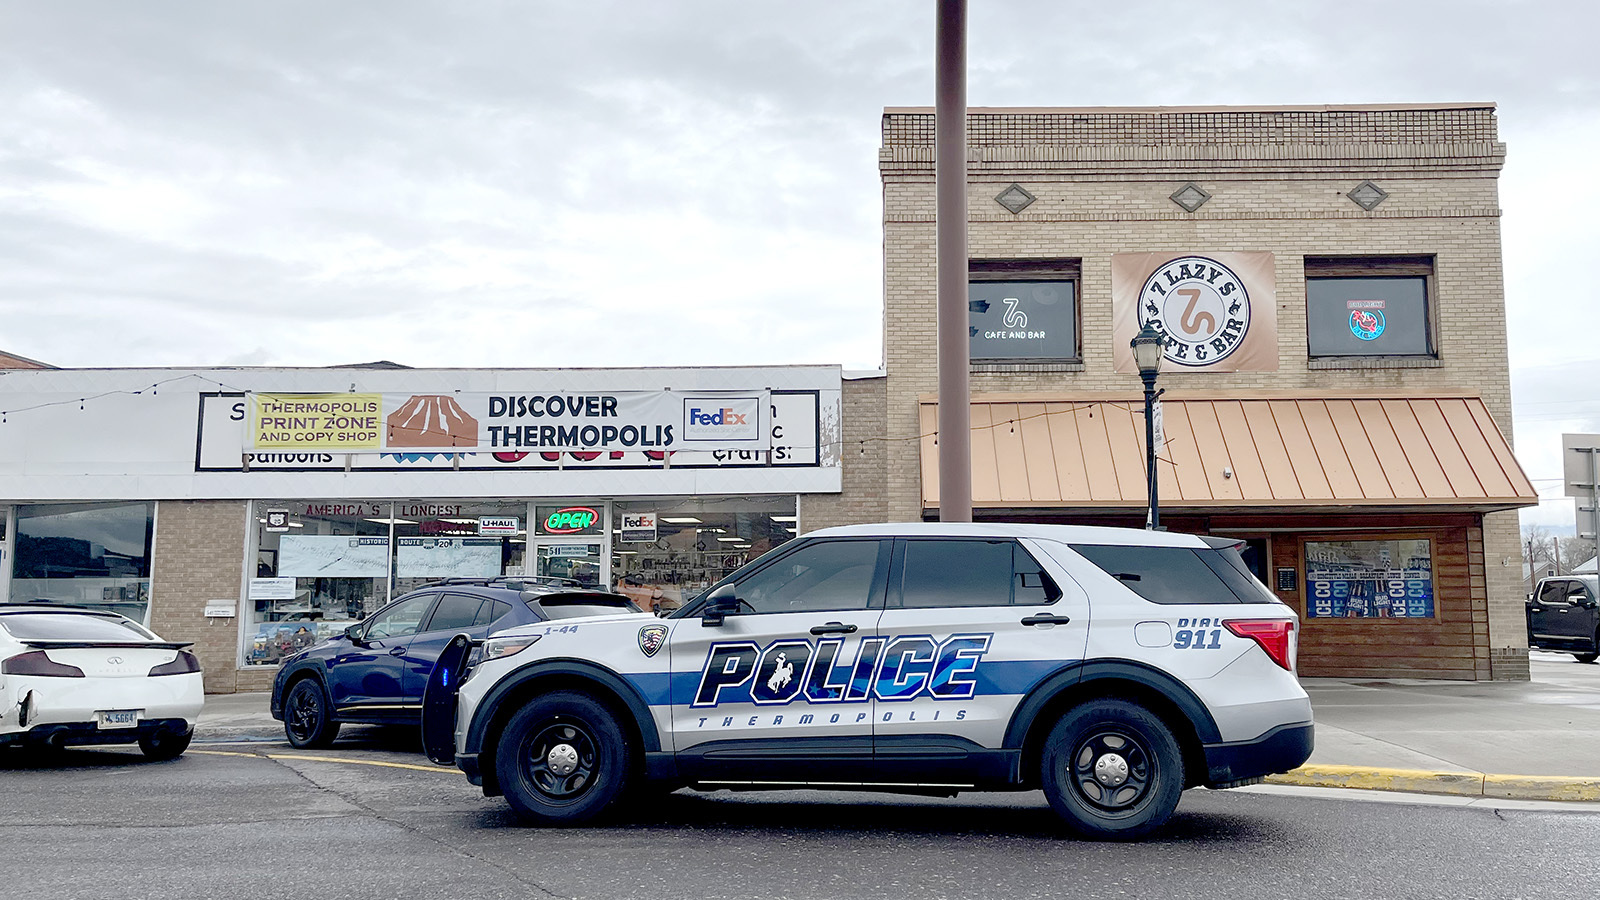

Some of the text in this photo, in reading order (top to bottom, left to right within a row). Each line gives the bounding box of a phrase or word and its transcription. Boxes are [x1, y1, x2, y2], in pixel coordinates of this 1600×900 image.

[1150, 263, 1237, 296] 7 LAZY S
[984, 331, 1046, 340] CAFE AND BAR
[1195, 344, 1208, 360] &
[1209, 318, 1244, 355] BAR
[261, 402, 377, 413] THERMOPOLIS
[488, 395, 618, 417] DISCOVER
[260, 417, 377, 429] PRINT ZONE
[690, 408, 746, 425] FedEx
[259, 432, 377, 442] AND COPY SHOP
[488, 424, 674, 448] THERMOPOLIS
[402, 505, 462, 516] LONGEST
[547, 513, 592, 528] OPEN
[624, 516, 653, 527] FedEx
[439, 540, 450, 548] 20
[1177, 618, 1221, 627] DIAL
[543, 625, 579, 636] 1-44
[1174, 629, 1221, 649] 911
[690, 632, 996, 709] POLICE
[697, 709, 968, 728] THERMOPOLIS
